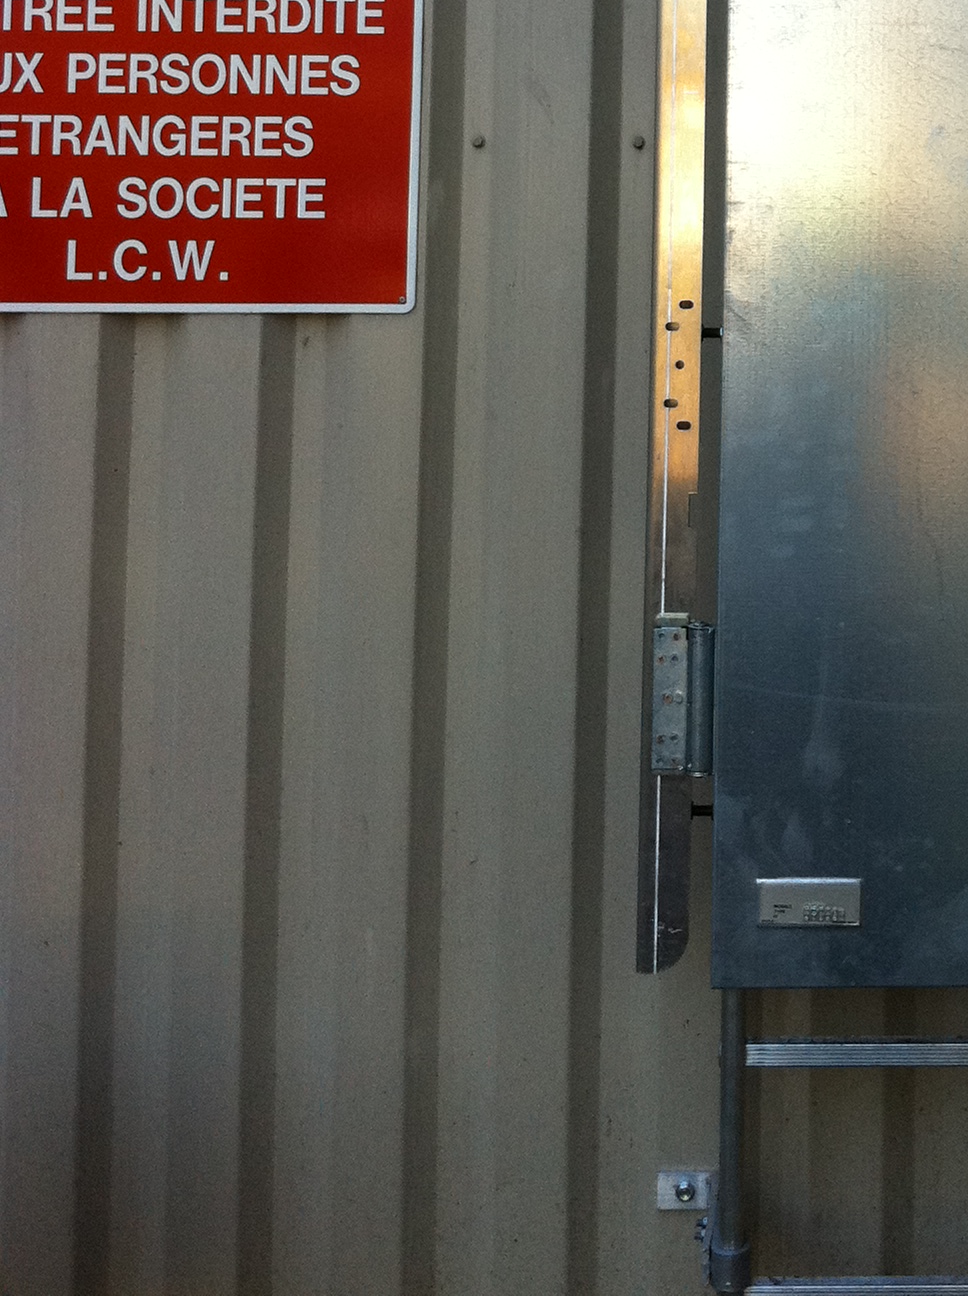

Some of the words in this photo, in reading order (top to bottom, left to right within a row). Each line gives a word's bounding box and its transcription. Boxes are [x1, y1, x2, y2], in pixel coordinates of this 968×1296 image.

[67, 52, 361, 96] PERSONNES
[0, 115, 314, 157] ETRANGERES
[31, 177, 93, 218] LA
[117, 177, 326, 219] SOCIETE
[65, 239, 229, 281] L.C.W.
